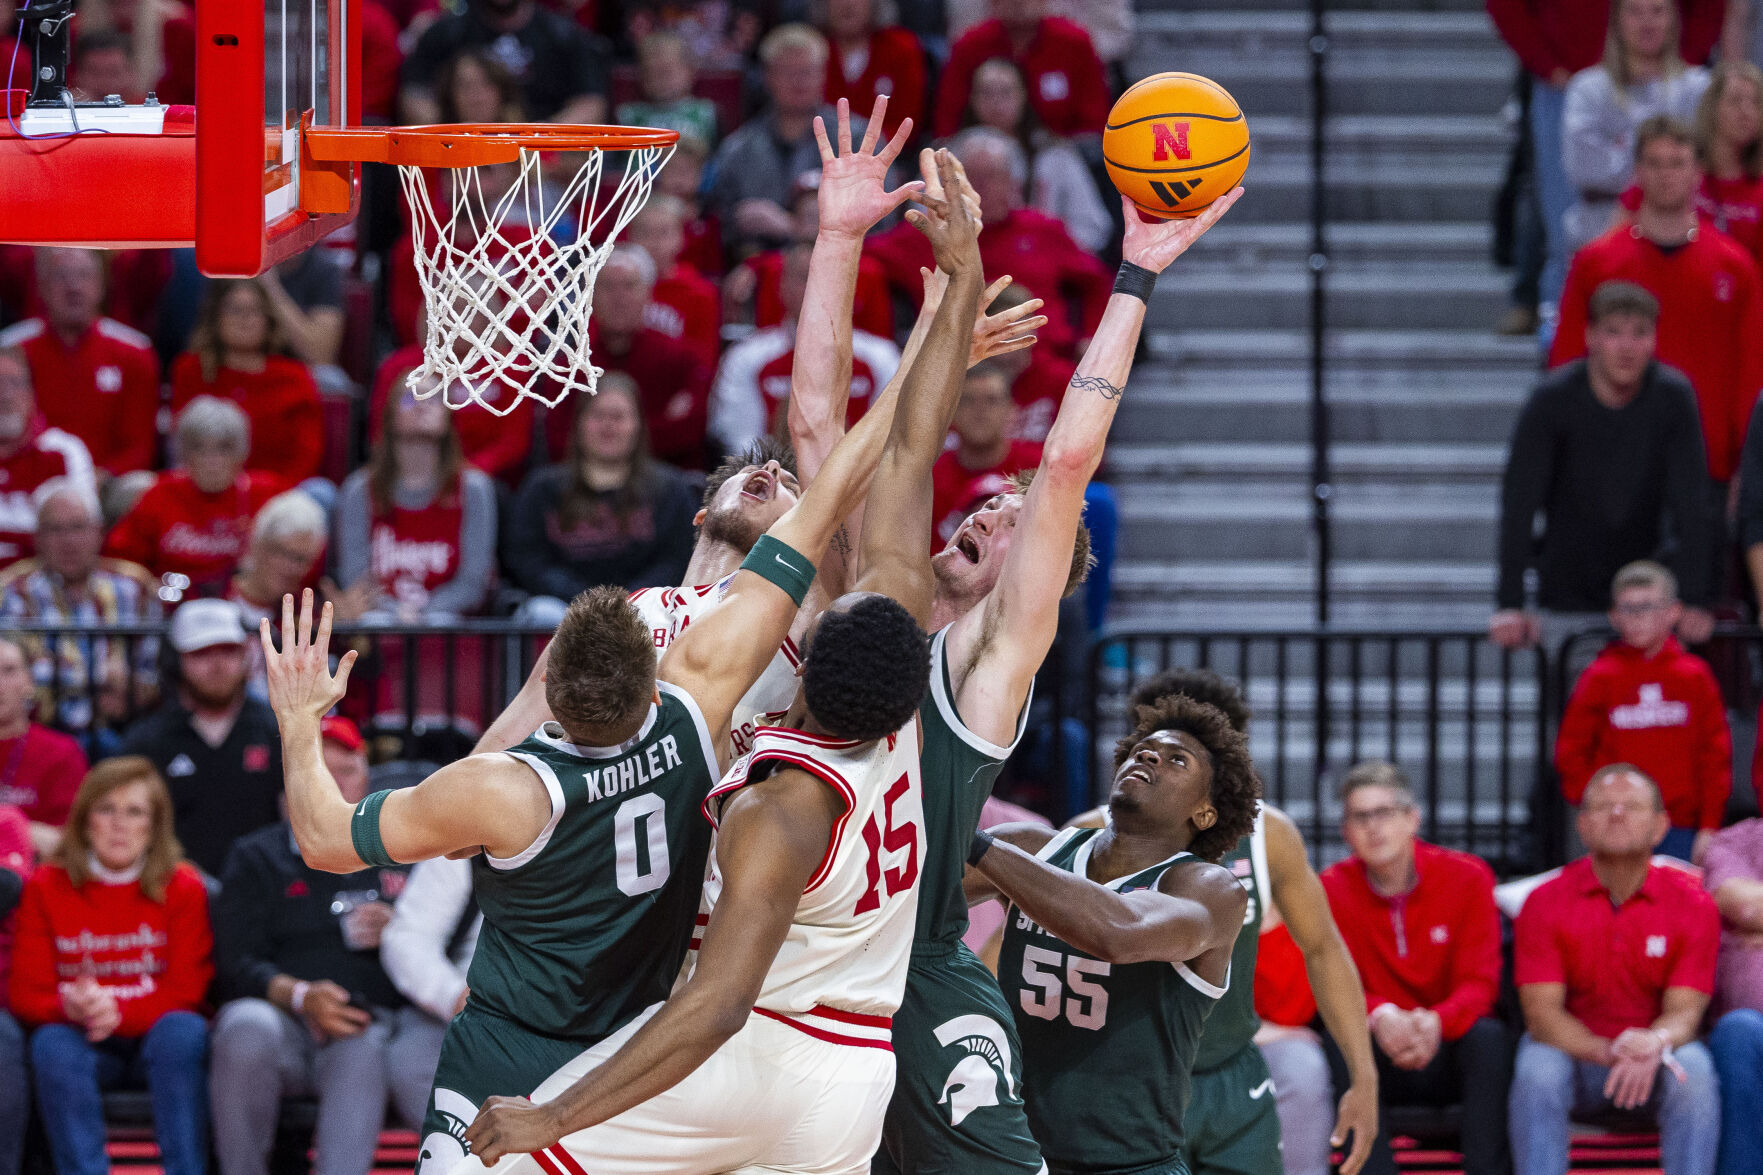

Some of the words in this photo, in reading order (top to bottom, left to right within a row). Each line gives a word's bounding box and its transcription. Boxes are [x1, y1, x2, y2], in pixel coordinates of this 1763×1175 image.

[1152, 122, 1191, 161] N
[582, 734, 683, 804] KOHLER
[614, 792, 670, 897] 0
[853, 770, 918, 917] 15
[1020, 944, 1111, 1031] 55
